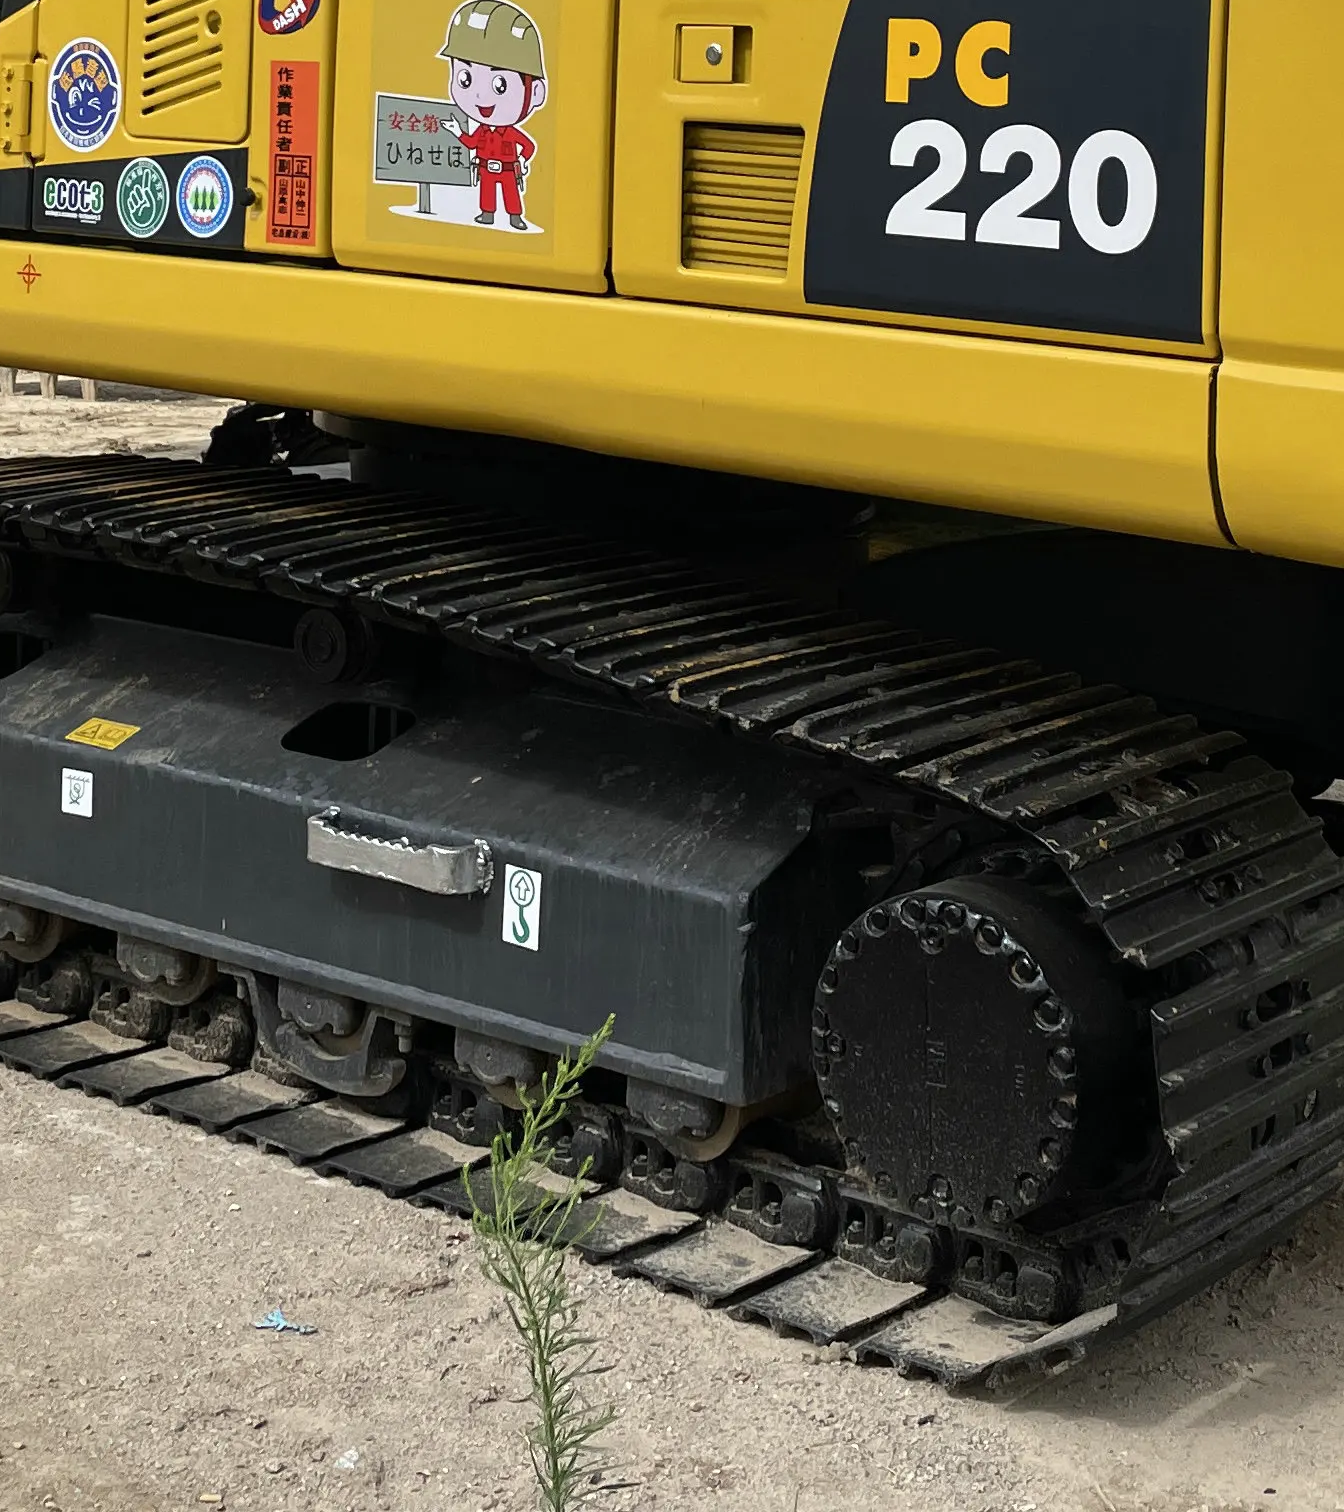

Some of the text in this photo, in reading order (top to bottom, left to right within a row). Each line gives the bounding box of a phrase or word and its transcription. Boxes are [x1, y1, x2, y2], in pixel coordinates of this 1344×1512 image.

[885, 18, 1012, 107] PC
[276, 67, 294, 152] 作業責任者
[295, 160, 308, 176] 正
[386, 142, 464, 167] ひねせほ
[44, 177, 104, 214] ecot3
[885, 119, 1157, 254] 220
